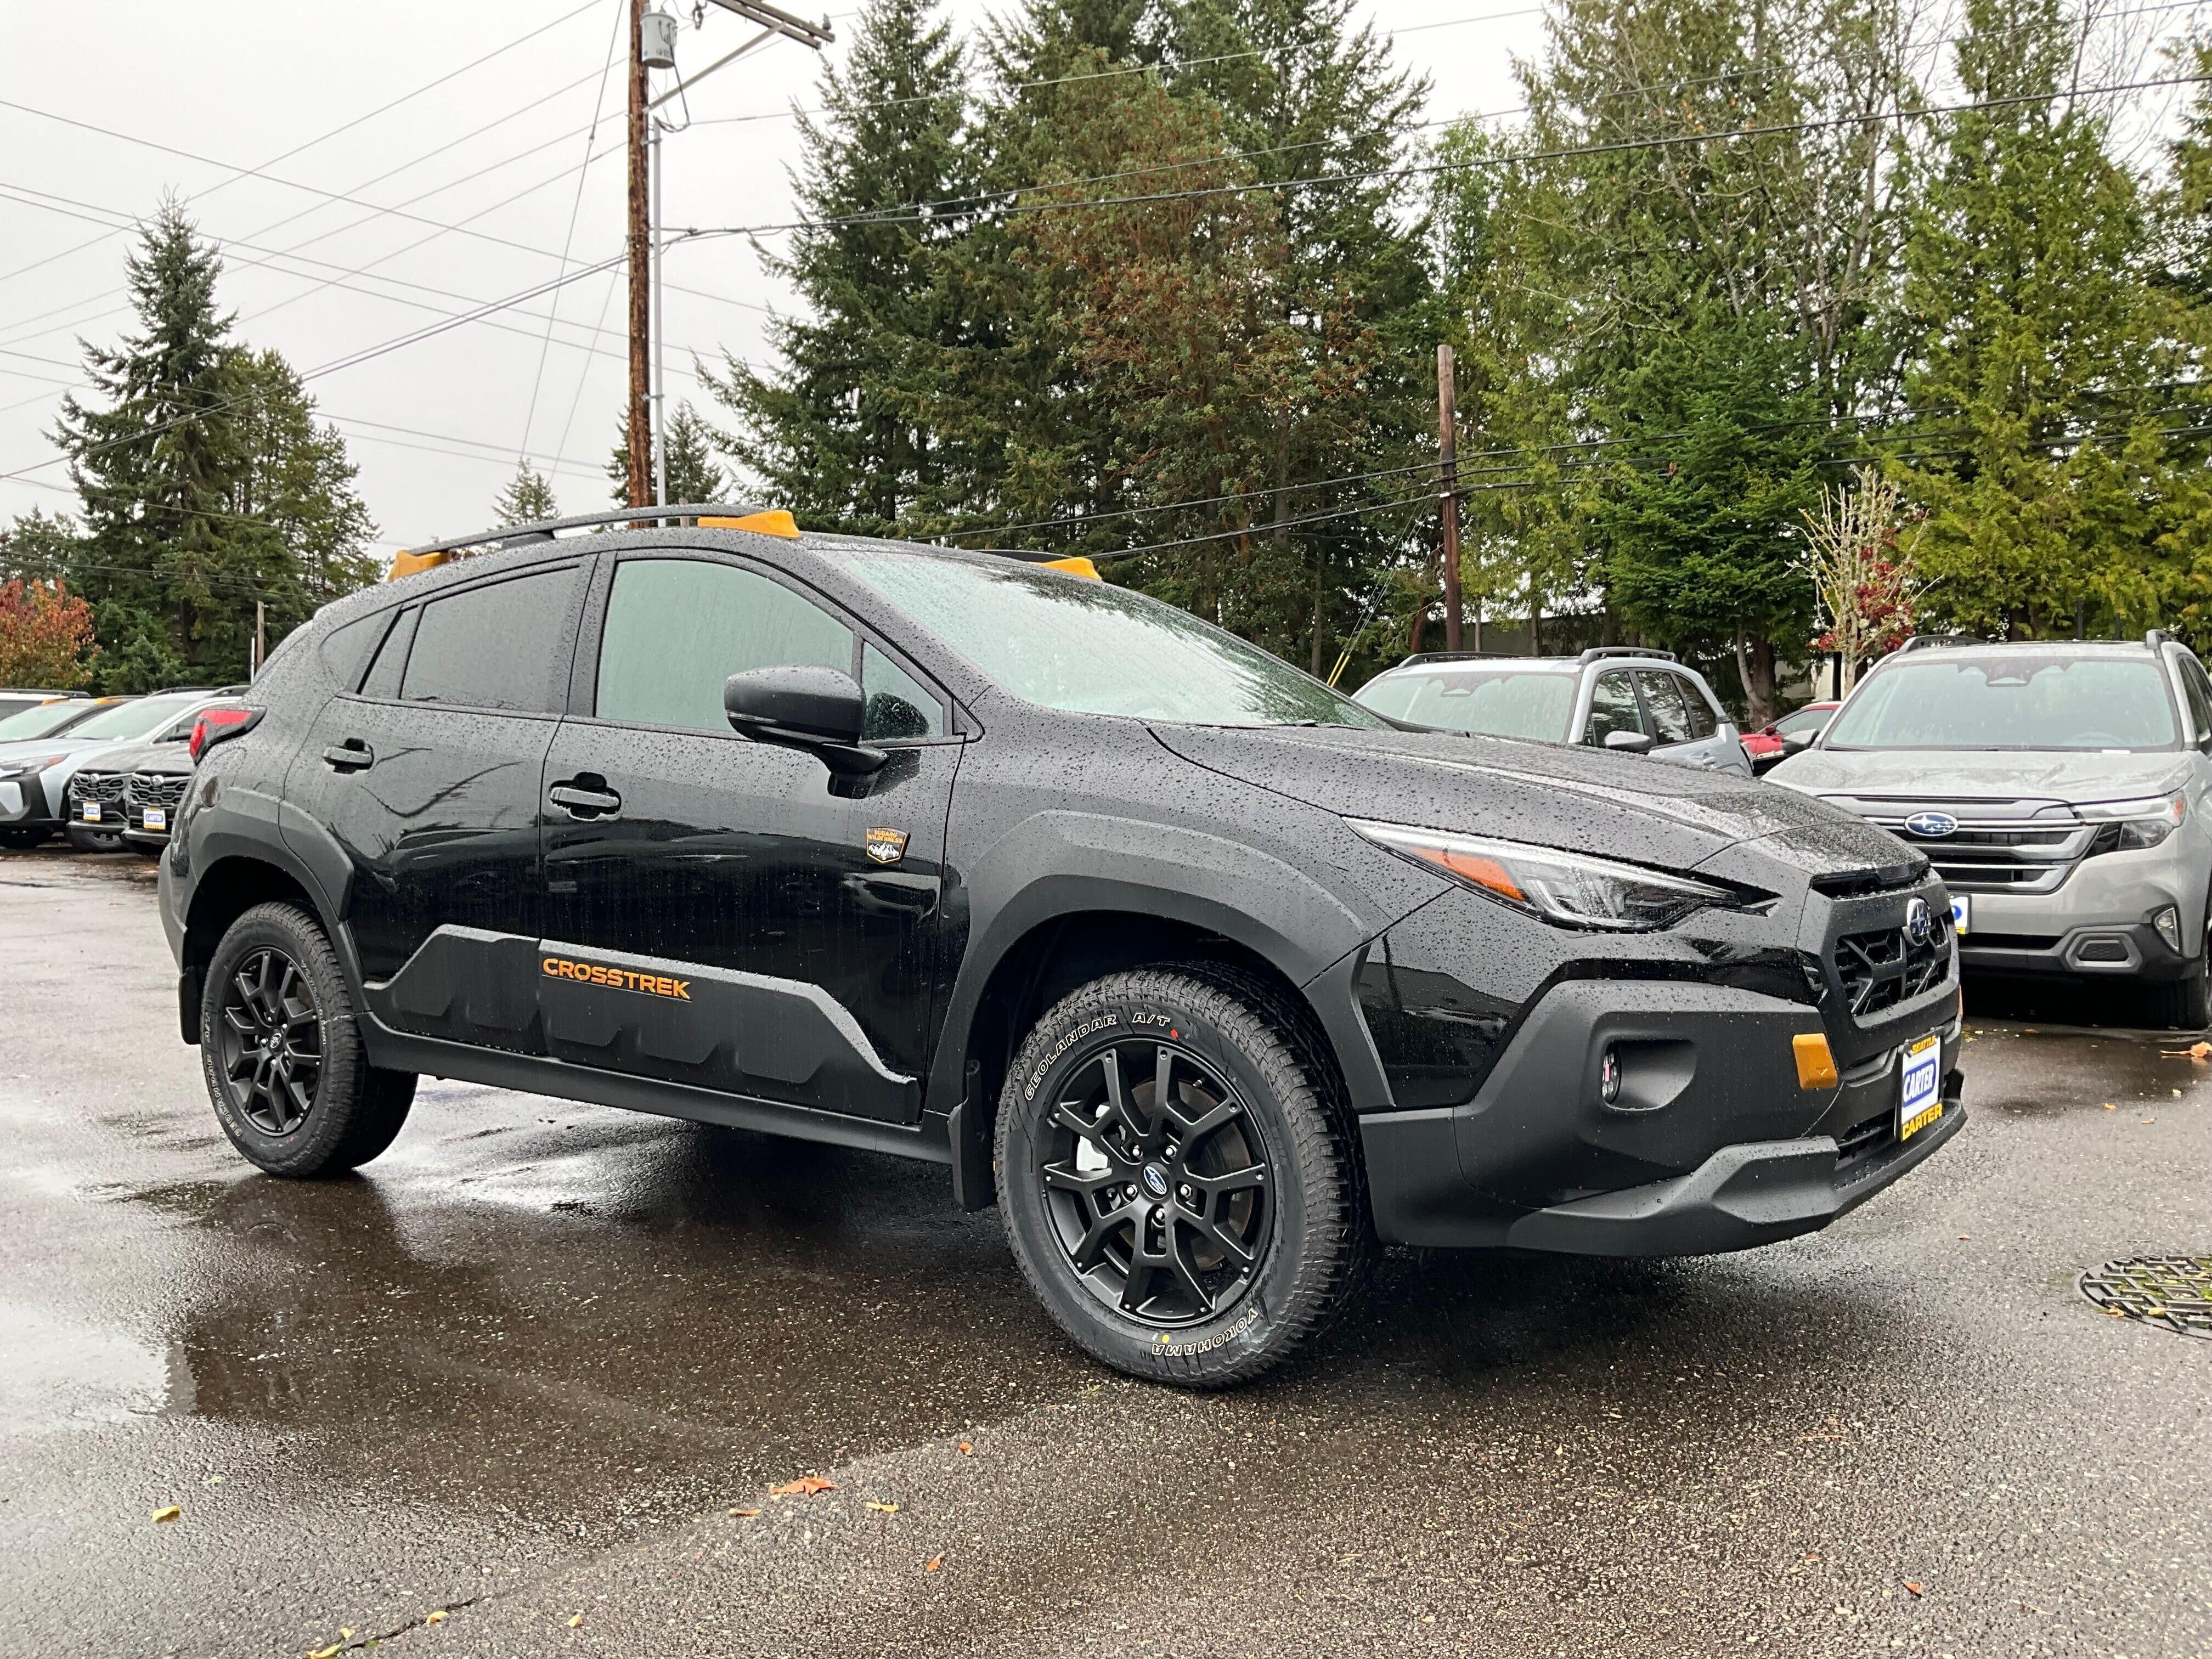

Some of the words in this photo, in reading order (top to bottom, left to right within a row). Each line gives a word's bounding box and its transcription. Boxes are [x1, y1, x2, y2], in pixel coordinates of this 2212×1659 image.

[868, 833, 903, 844] WILDERNESS
[874, 830, 898, 838] SUBARU
[543, 958, 691, 1000] CROSSTREK
[1024, 1015, 1117, 1101] GEOLANDAR
[1132, 1012, 1171, 1027] A/T
[1903, 1064, 1934, 1102] CARTER
[1902, 1103, 1943, 1141] CARTER
[1152, 1307, 1259, 1356] YOKOHAMA
